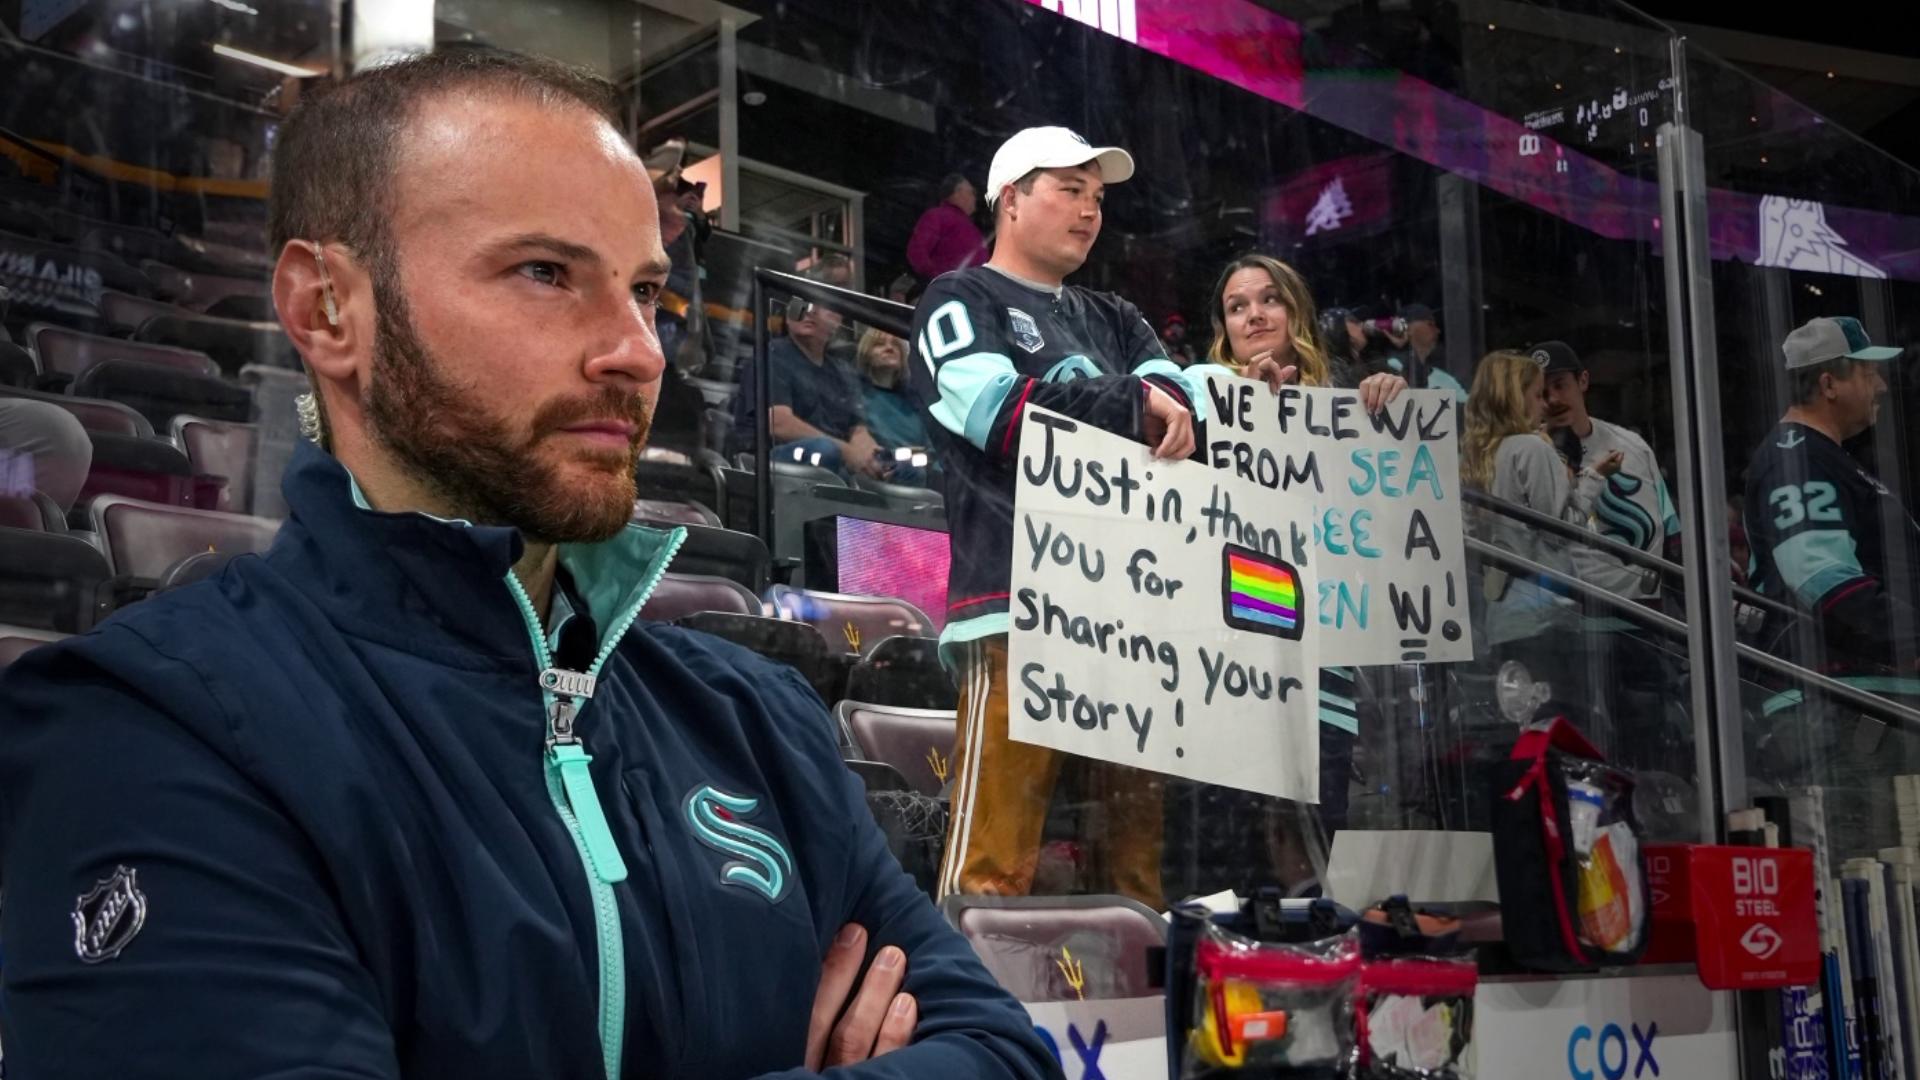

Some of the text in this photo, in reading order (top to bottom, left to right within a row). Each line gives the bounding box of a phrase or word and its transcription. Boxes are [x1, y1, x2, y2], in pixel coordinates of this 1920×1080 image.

[1208, 376, 1415, 440] WE FLEW
[1023, 411, 1308, 567] Justin, thank
[1211, 440, 1444, 500] FROM SEA
[1769, 480, 1842, 530] 32
[1313, 506, 1442, 561] EE A
[1126, 548, 1184, 600] for
[1731, 857, 1779, 895] BIO
[1735, 898, 1781, 917] STEEL
[1567, 1021, 1660, 1080] COX
